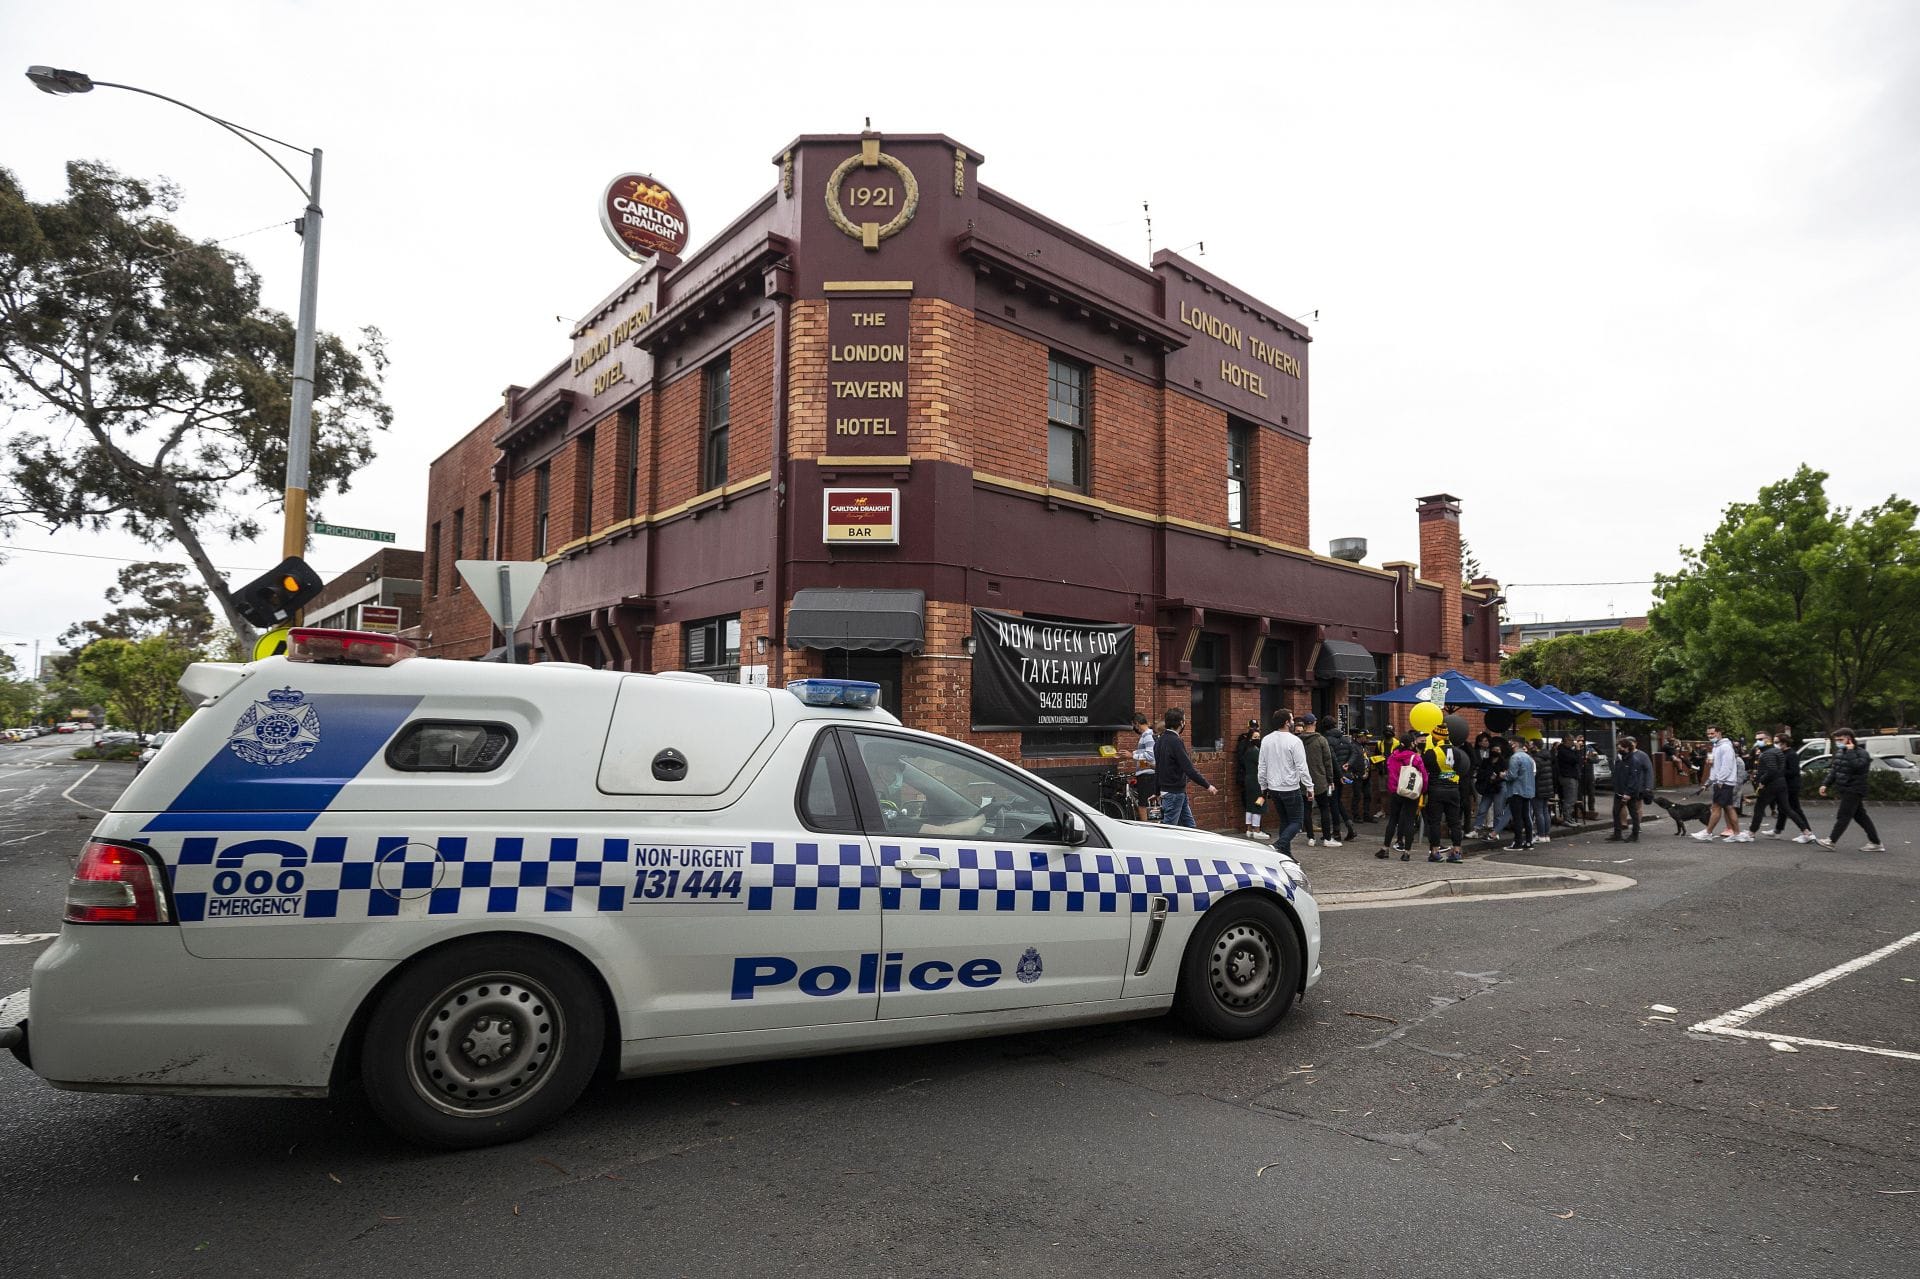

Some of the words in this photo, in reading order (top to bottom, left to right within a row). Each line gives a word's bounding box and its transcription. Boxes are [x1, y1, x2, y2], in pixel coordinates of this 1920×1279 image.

[849, 187, 895, 207] 1921
[613, 196, 684, 235] CARLTON
[622, 213, 677, 241] DRAUGHT
[852, 312, 886, 326] THE
[573, 335, 610, 377] LONDON
[611, 303, 651, 348] TAVERN
[1180, 300, 1242, 351] LONDON
[1248, 335, 1301, 379] TAVERN
[831, 344, 904, 362] LONDON
[593, 361, 625, 398] HOTEL
[1220, 359, 1268, 399] HOTEL
[832, 381, 904, 398] TAVERN
[836, 418, 897, 436] HOTEL
[325, 525, 375, 540] RICHMOND
[379, 532, 395, 543] TCE
[848, 527, 872, 537] BAR
[998, 621, 1034, 649] NOW
[1042, 627, 1083, 653] OPEN
[1089, 631, 1117, 655] FOR
[1020, 657, 1101, 686] TAKEAWAY
[1432, 681, 1445, 690] 2P
[1039, 692, 1063, 709] 9428
[1065, 692, 1088, 709] 6058
[257, 713, 298, 728] VICTORIA
[635, 848, 744, 867] NON-URGENT
[632, 869, 681, 899] 131
[681, 870, 743, 899] 444
[208, 897, 302, 916] EMERGENCY
[731, 952, 1002, 1001] Police
